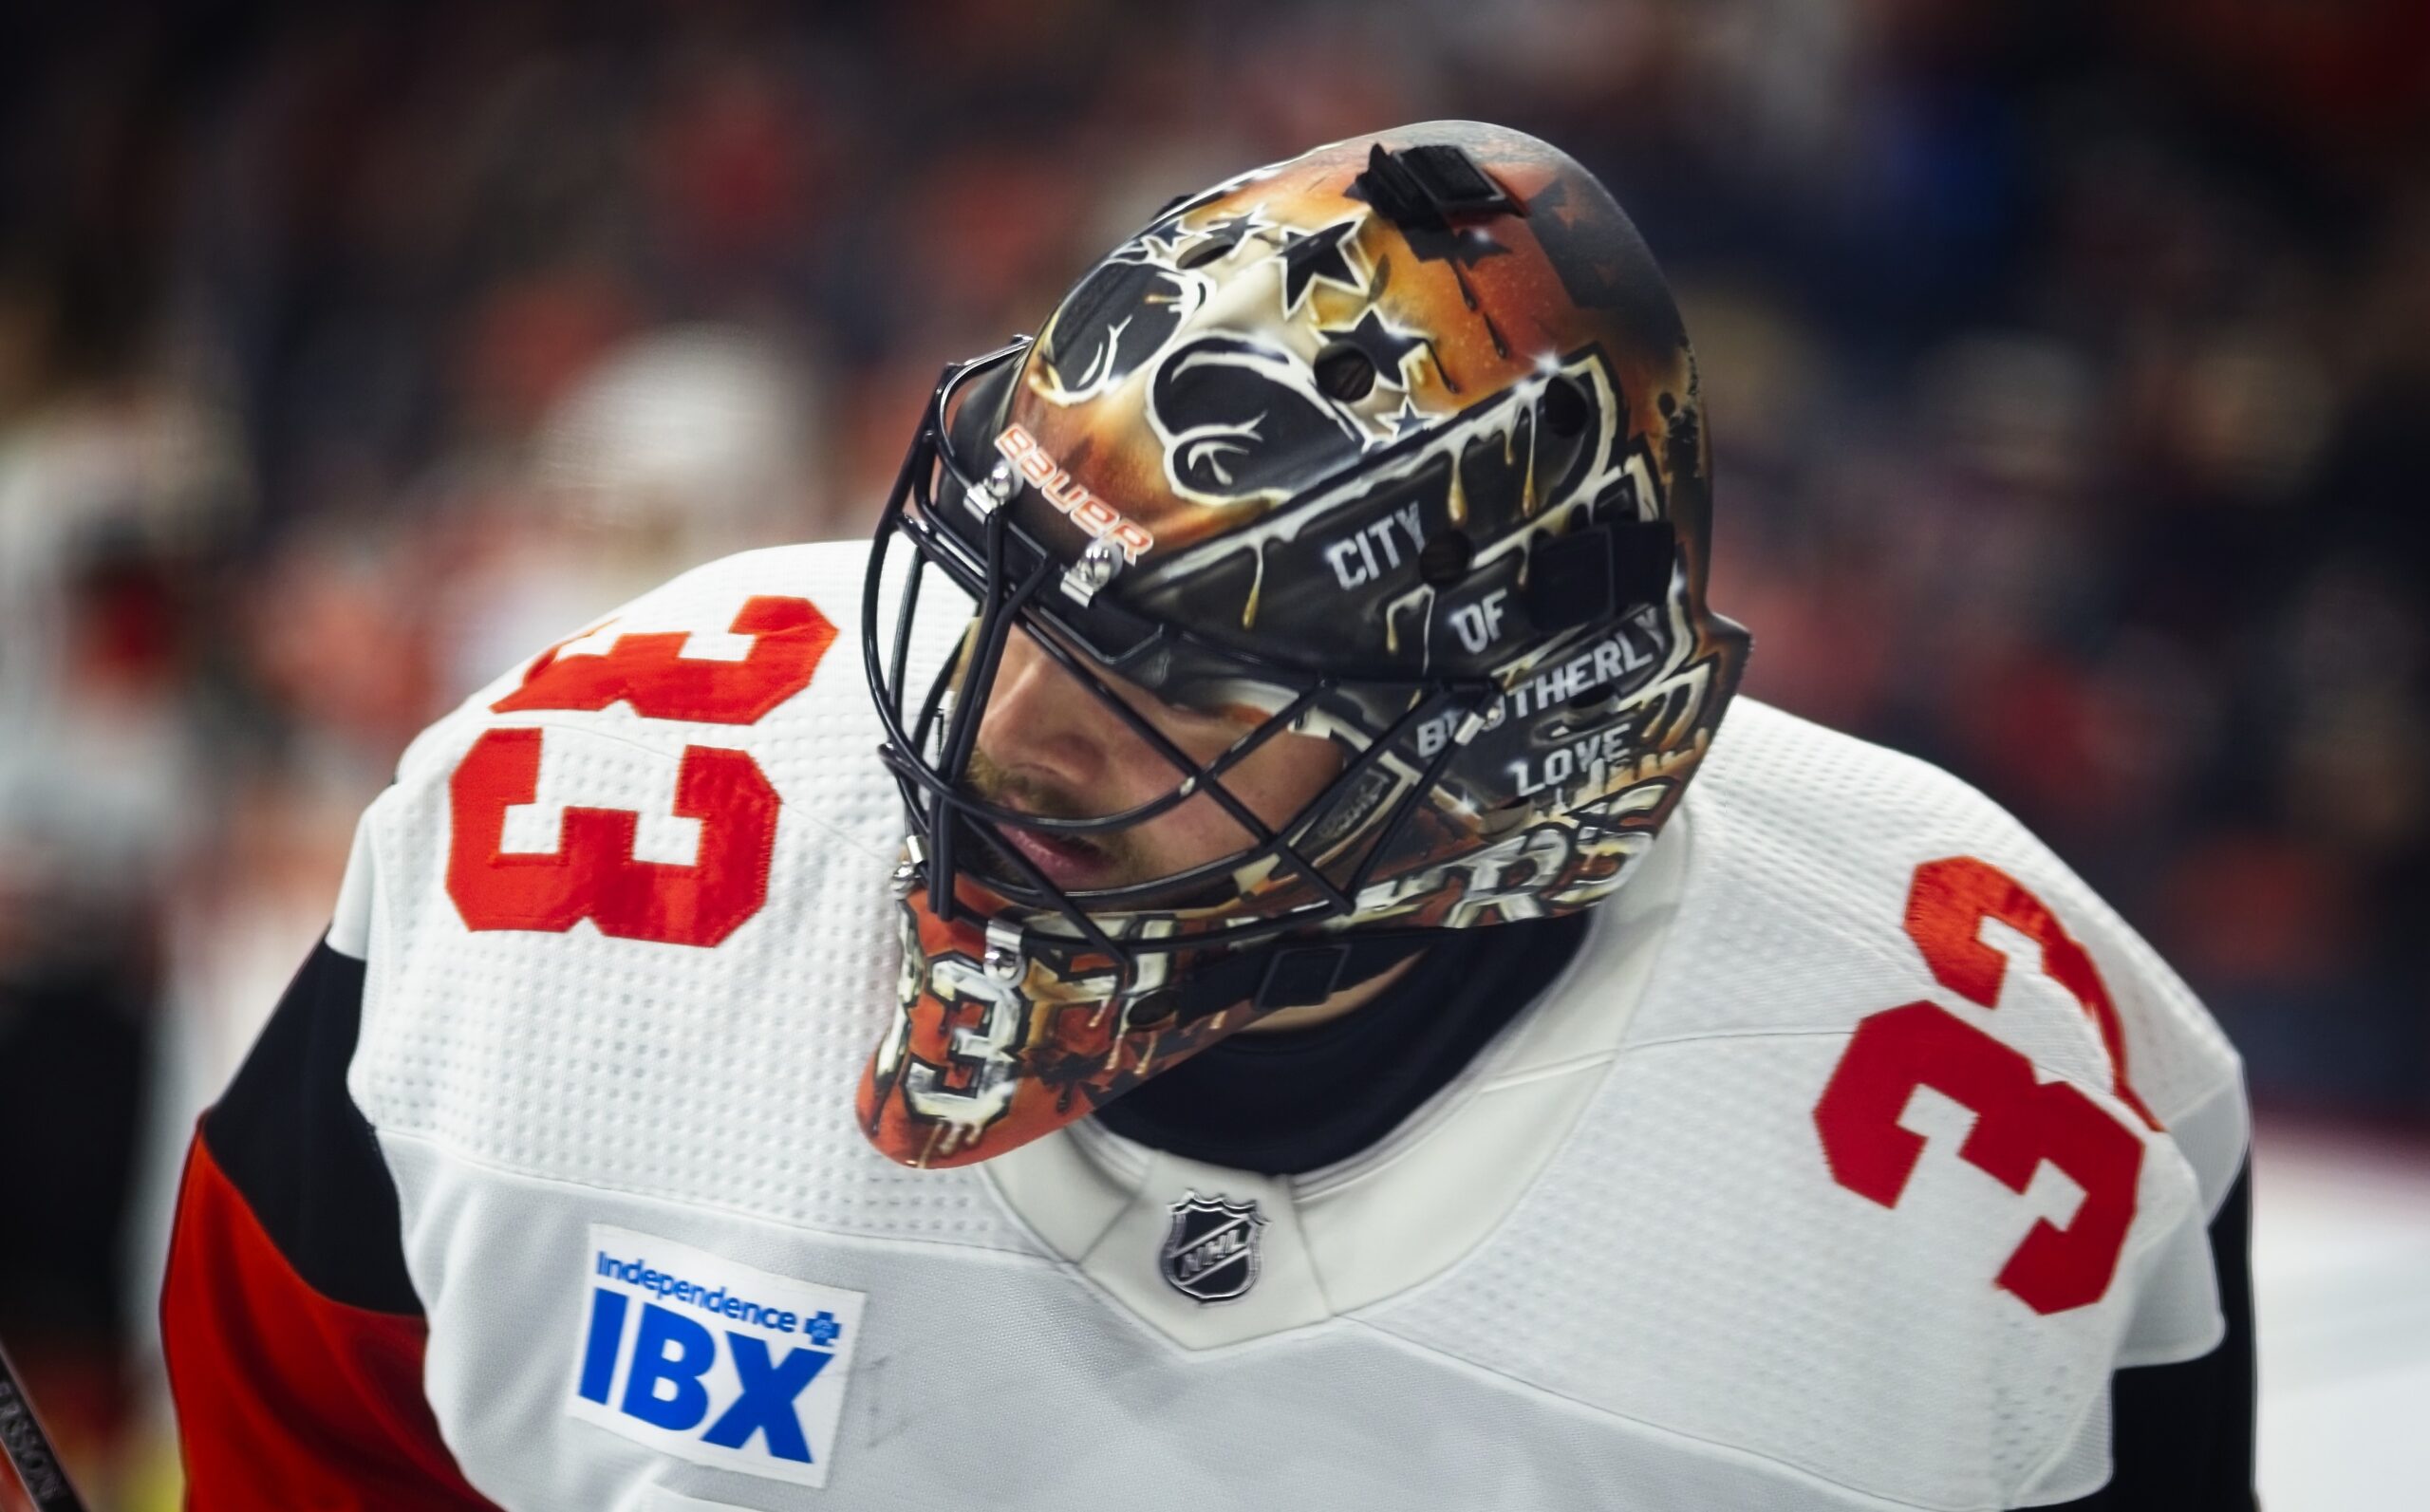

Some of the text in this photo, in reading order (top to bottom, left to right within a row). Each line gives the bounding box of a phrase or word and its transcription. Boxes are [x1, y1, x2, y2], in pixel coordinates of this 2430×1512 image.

[1328, 502, 1425, 590] CITY
[1450, 588, 1507, 654] OF
[1509, 723, 1632, 797] LOVE
[596, 1250, 797, 1334] Independence
[1179, 1229, 1246, 1279] NHL
[578, 1286, 836, 1465] IBX
